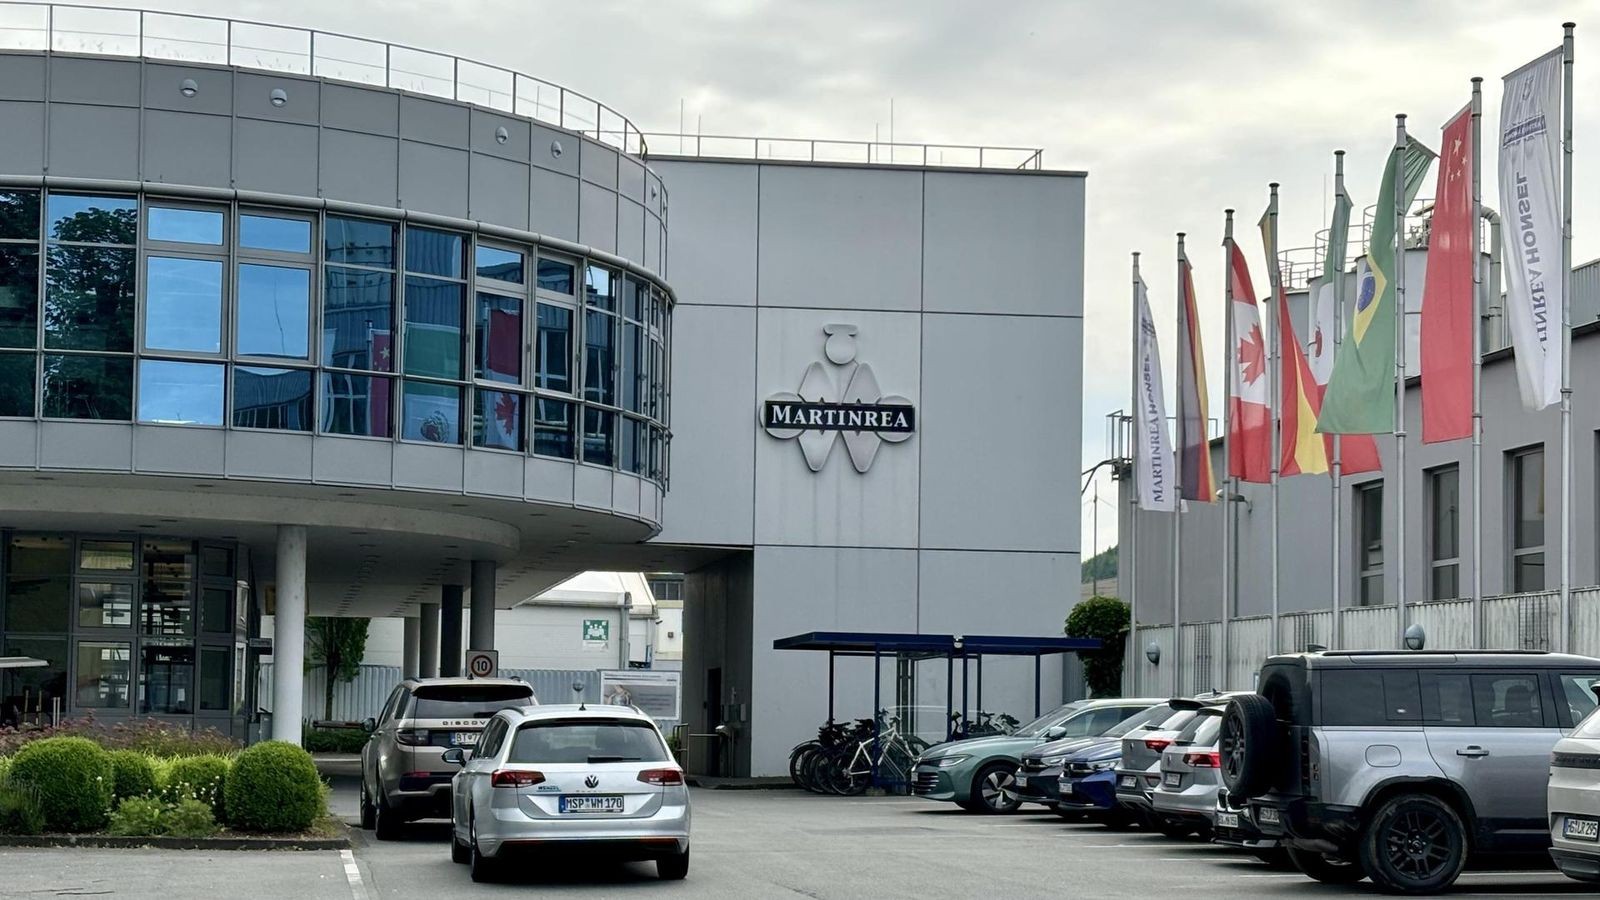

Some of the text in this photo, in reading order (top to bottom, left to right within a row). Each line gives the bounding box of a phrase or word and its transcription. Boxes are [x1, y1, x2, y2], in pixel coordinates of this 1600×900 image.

[771, 404, 909, 428] MARTINREA
[1149, 416, 1164, 503] MARTINREA
[476, 660, 488, 672] 10
[566, 797, 622, 809] MSP WM 170
